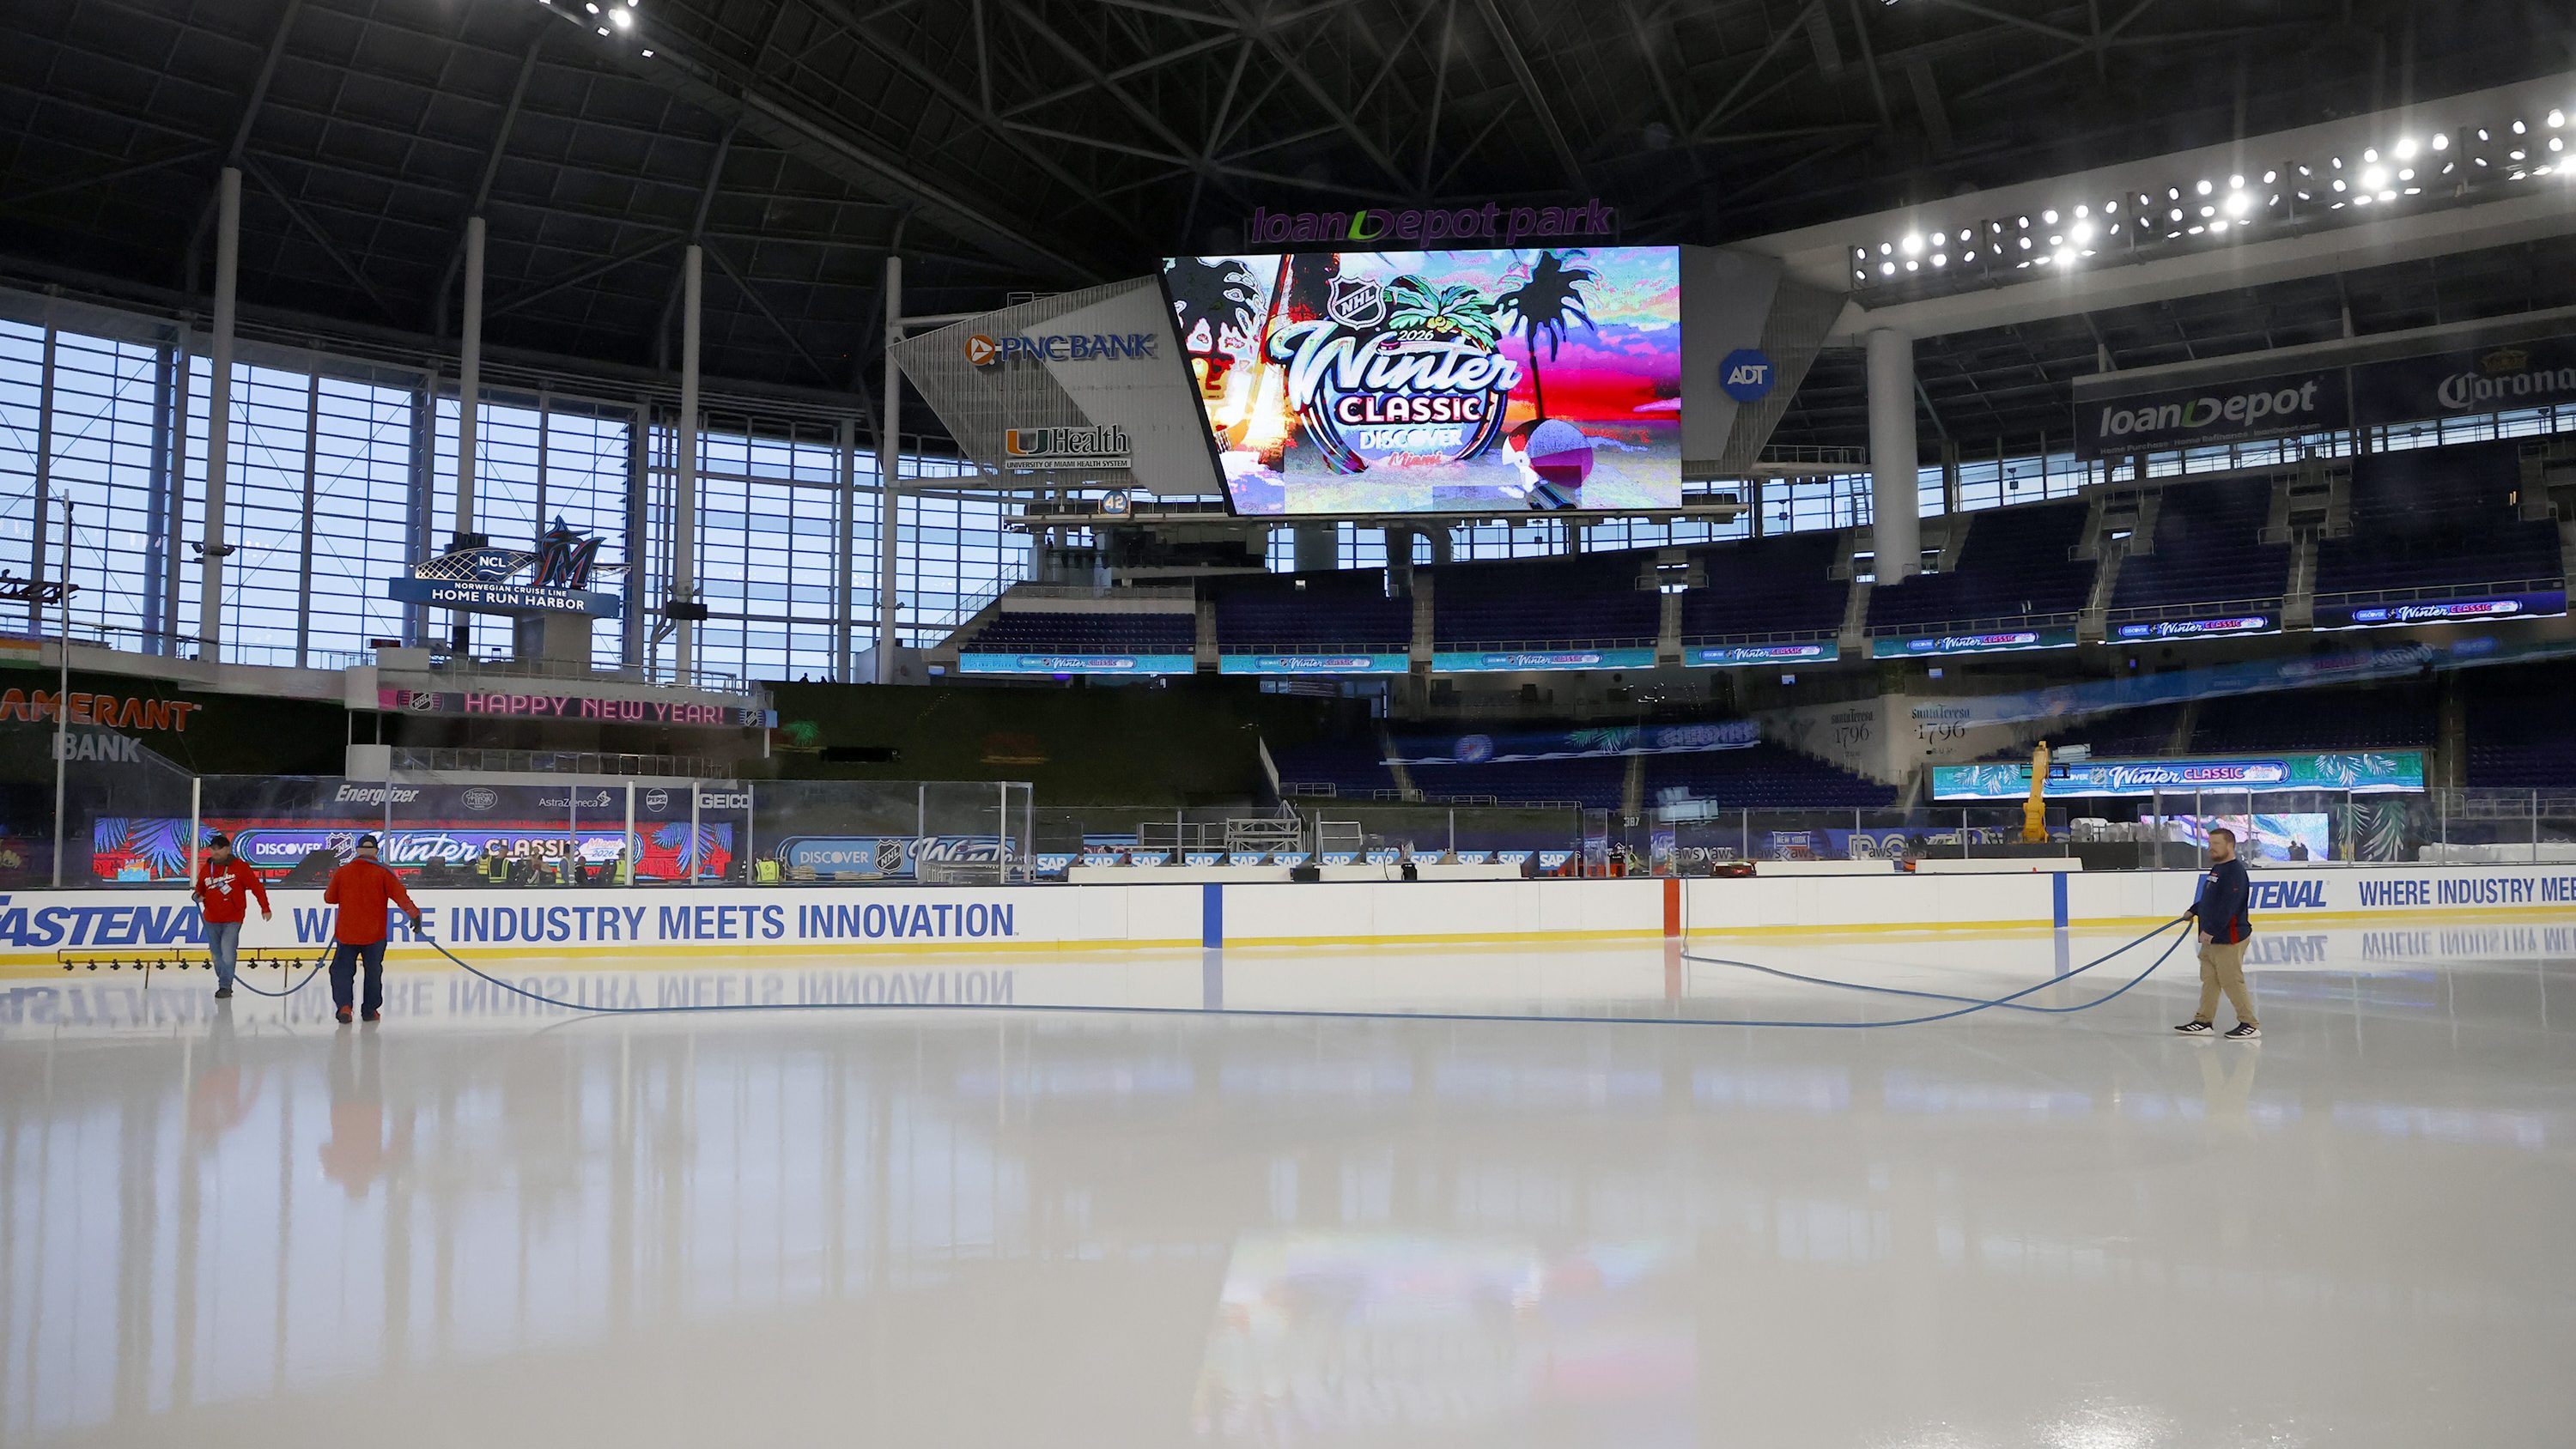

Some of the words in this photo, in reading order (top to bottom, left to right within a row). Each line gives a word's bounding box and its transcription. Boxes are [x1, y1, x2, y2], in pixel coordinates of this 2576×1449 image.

[1251, 202, 1500, 248] loanDepot
[1505, 198, 1614, 246] park
[1340, 287, 1376, 317] NHL
[1398, 330, 1435, 342] 2026
[1268, 320, 1523, 412] Winter
[1727, 365, 1768, 385] ADT
[2437, 367, 2576, 411] Corona
[1339, 396, 1483, 423] CLASSIC
[2099, 380, 2318, 438] loanDepot
[1006, 423, 1130, 456] UHealth
[1360, 428, 1463, 450] DISCOVER
[1388, 452, 1443, 469] Miami
[1103, 494, 1125, 509] 42
[479, 555, 507, 568] NCL
[454, 582, 512, 593] NORWEGIAN
[514, 585, 545, 596] CRUISE
[548, 589, 568, 597] LINE
[432, 588, 480, 603] HOME
[486, 592, 519, 605] RUN
[526, 595, 585, 610] HARBOR
[2398, 605, 2448, 621] Winter
[2450, 603, 2492, 614] CLASSIC
[2159, 621, 2203, 637] Winter
[2204, 620, 2242, 629] CLASSIC
[1942, 636, 1982, 650] Winter
[1983, 634, 2016, 644] CLASSIC
[1516, 653, 1552, 666] Winter
[1734, 647, 1770, 660] Winter
[1050, 657, 1087, 671] Winter
[1289, 657, 1323, 670] Winter
[0, 688, 194, 732] AMERANT
[465, 692, 568, 717] HAPPY
[580, 698, 645, 720] NEW
[653, 702, 725, 724] YEAR!
[52, 732, 142, 763] BANK
[2108, 766, 2181, 791] Winter
[2184, 767, 2245, 780] CLASSIC
[334, 785, 420, 806] Energizer
[698, 793, 750, 809] GEICO
[255, 843, 322, 856] DISCOVER
[368, 830, 479, 863] Winter
[586, 837, 623, 849] Miami
[799, 851, 869, 864] DISCOVER
[878, 848, 901, 869] NHL
[1322, 855, 1351, 865] SAP
[1366, 855, 1394, 865] SAP
[1410, 855, 1438, 865] SAP
[1457, 854, 1485, 865] SAP
[1499, 854, 1527, 864] SAP
[1540, 854, 1566, 867] SAP
[1868, 847, 1893, 858] aws
[1037, 857, 1067, 870] SAP
[1084, 857, 1114, 868] SAP
[1132, 857, 1162, 867] SAP
[1185, 857, 1215, 867] SAP
[1230, 856, 1259, 867] SAP
[1273, 856, 1303, 867] SAP
[2359, 880, 2431, 906] WHERE
[2438, 878, 2535, 904] INDUSTRY
[0, 895, 210, 947] ASTENA
[294, 907, 435, 943] WRE
[452, 906, 647, 942] INDUSTRY
[659, 906, 785, 940] MEETS
[799, 903, 1014, 938] INNOVATION
